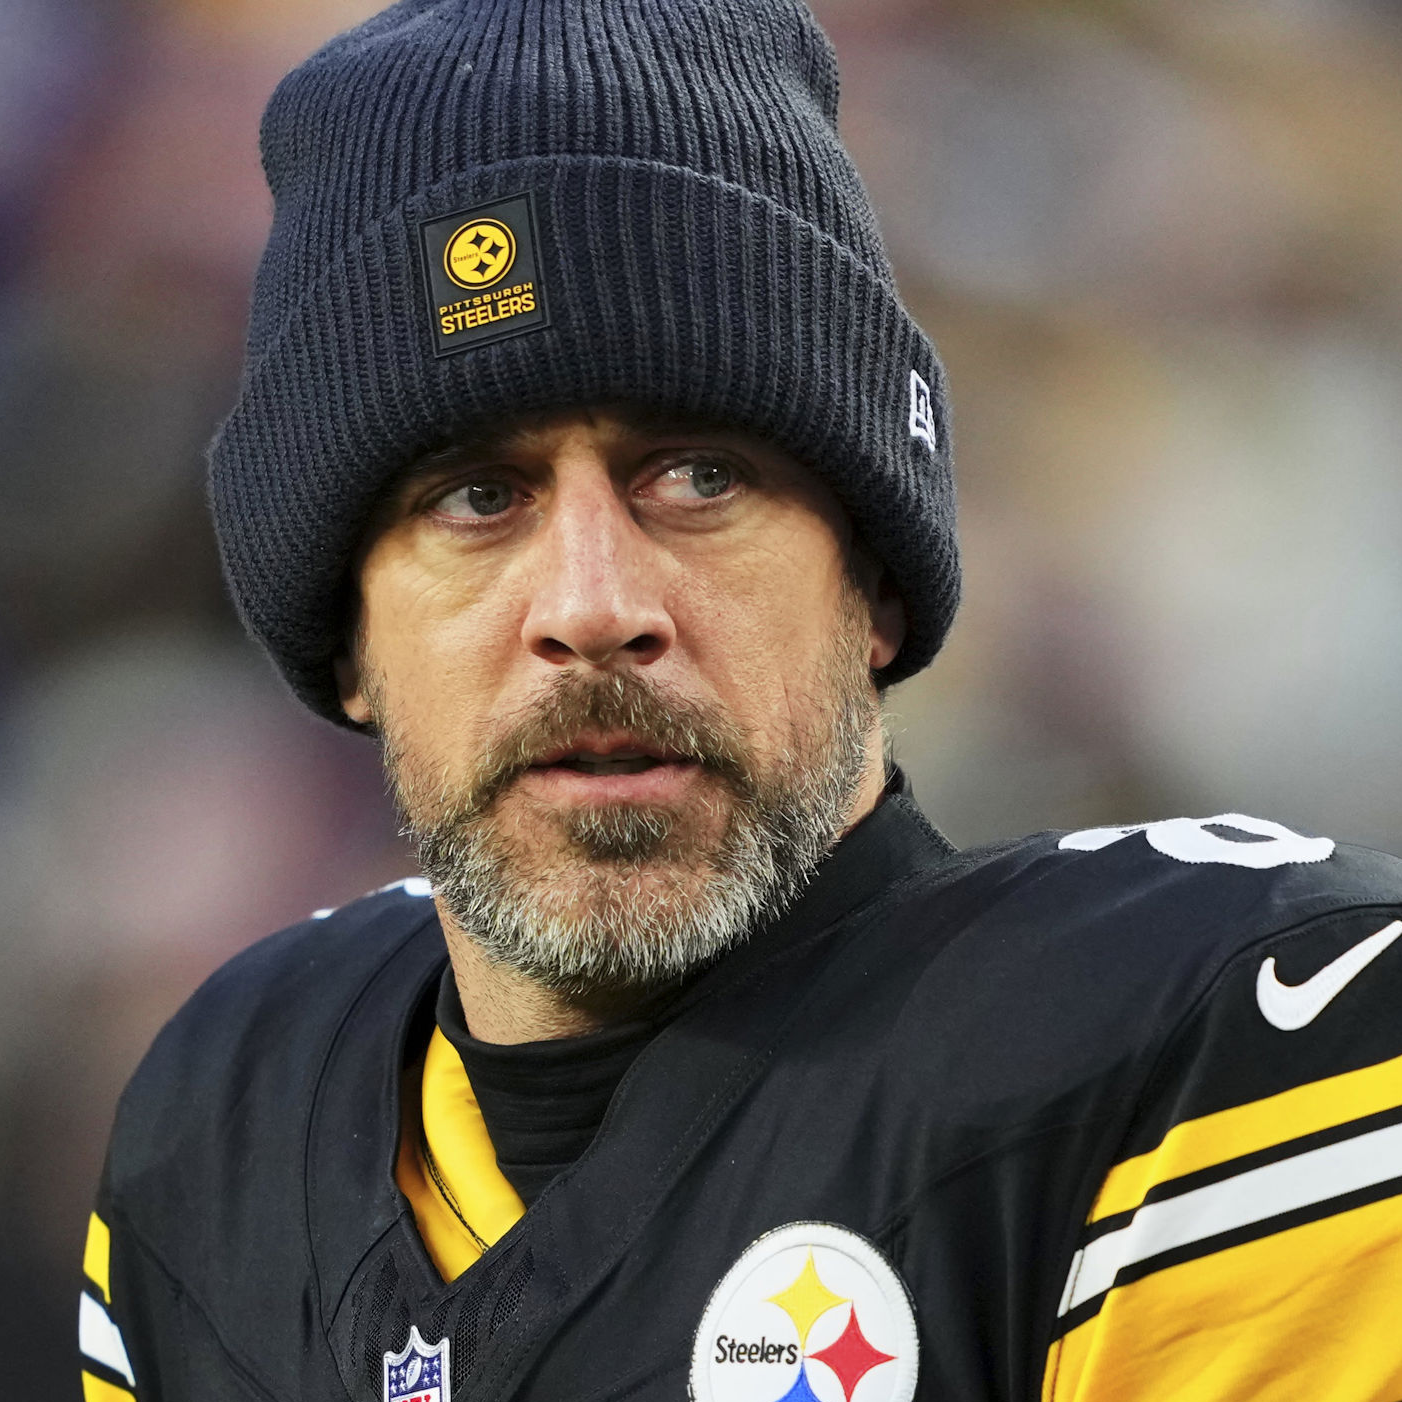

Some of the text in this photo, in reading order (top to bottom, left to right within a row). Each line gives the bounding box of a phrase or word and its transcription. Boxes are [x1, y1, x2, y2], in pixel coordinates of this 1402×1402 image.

[453, 252, 479, 264] Steelers
[439, 282, 533, 315] PITTSBURGH
[440, 293, 536, 335] STEELERS
[715, 1335, 798, 1365] Steelers
